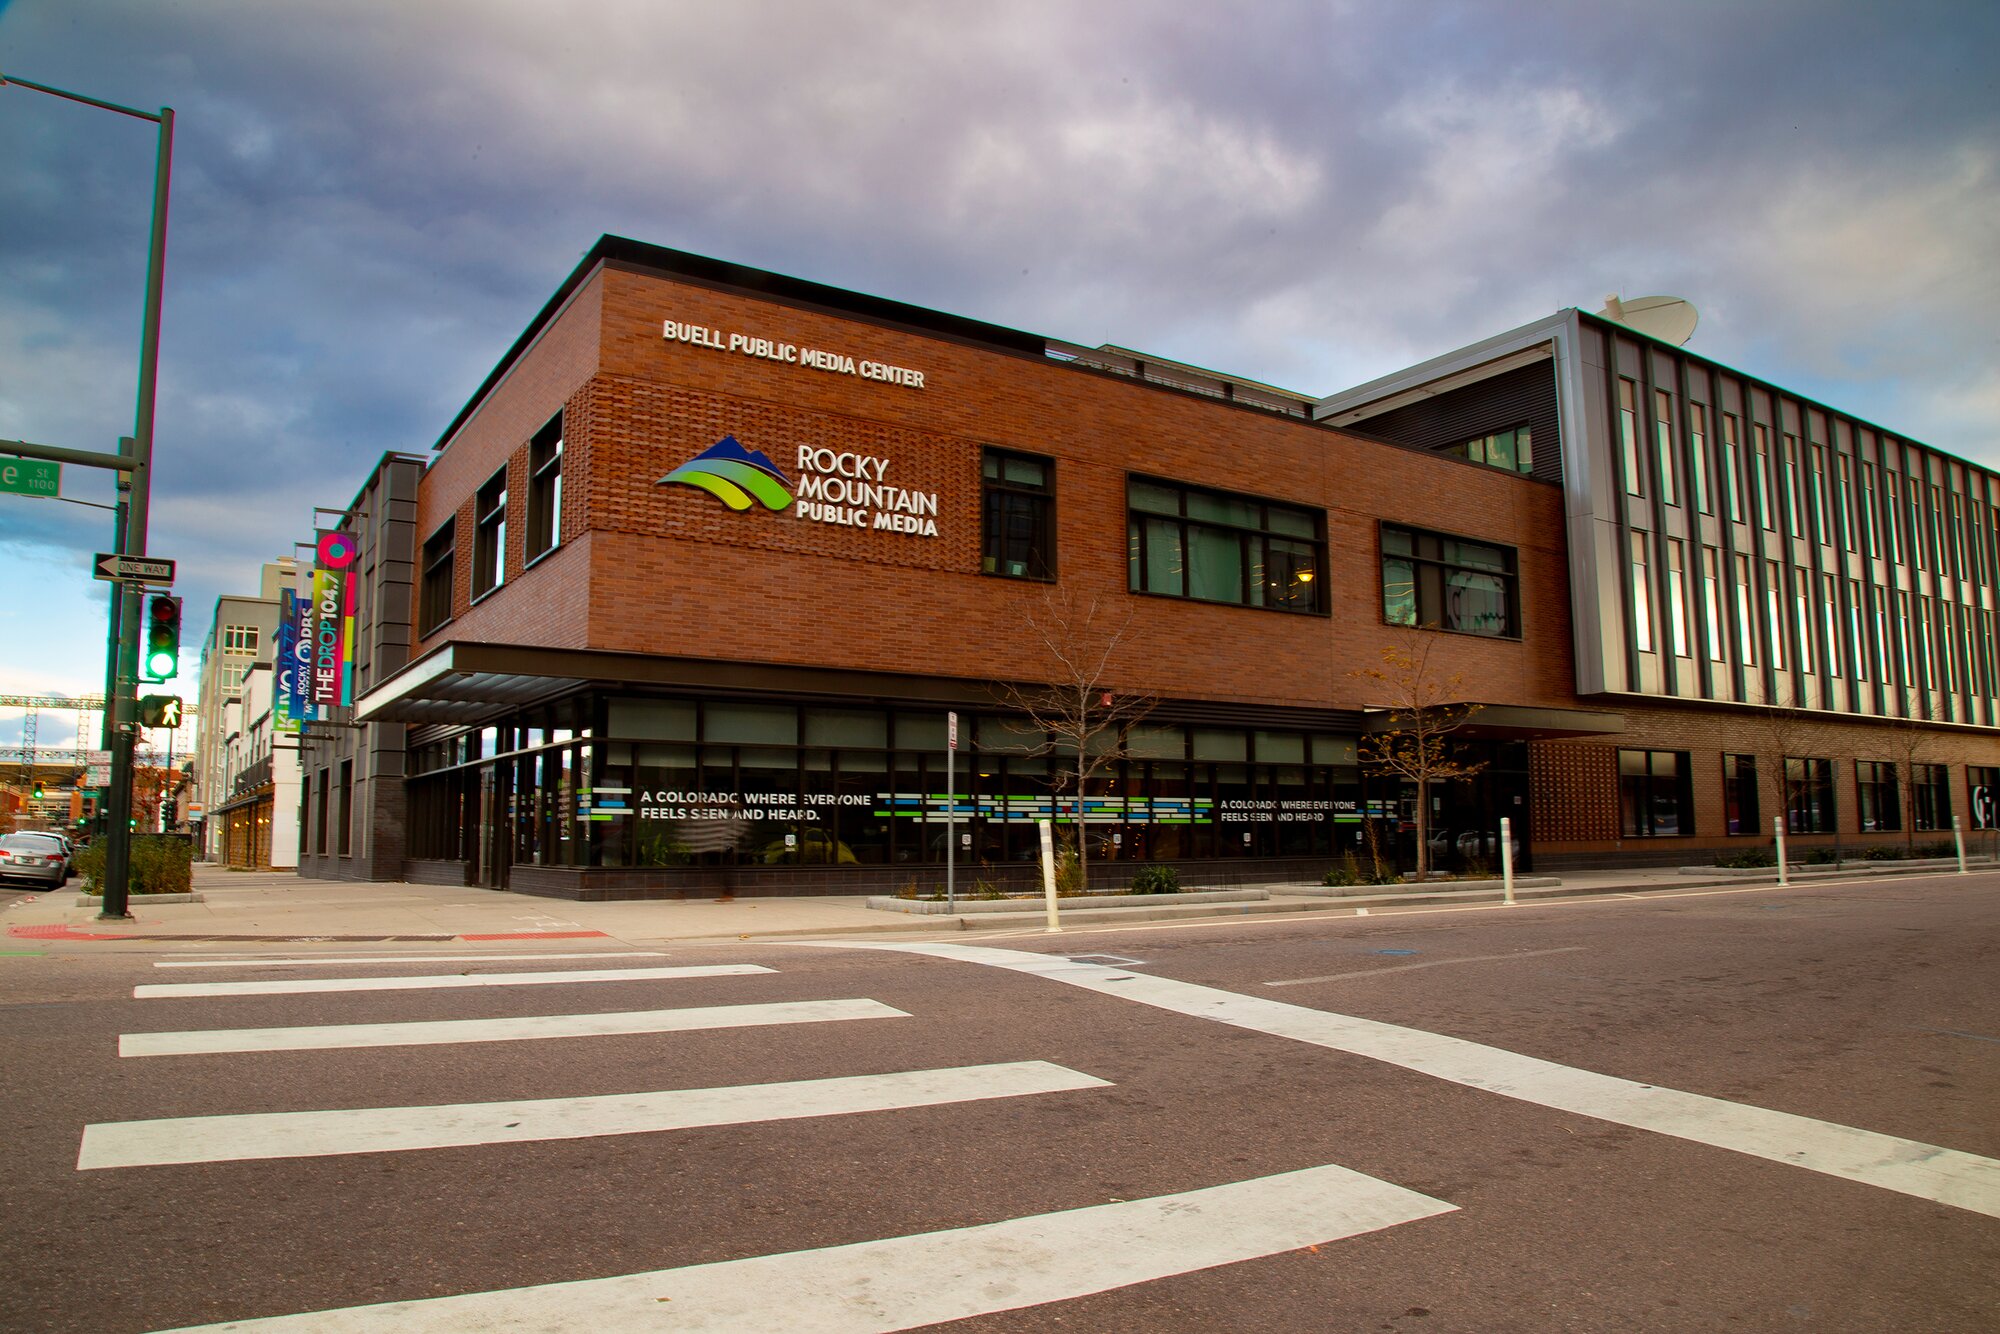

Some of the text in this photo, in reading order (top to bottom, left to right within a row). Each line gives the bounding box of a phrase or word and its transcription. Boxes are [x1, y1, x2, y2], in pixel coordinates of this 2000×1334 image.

[663, 320, 925, 388] BUELL PUBLIC MEDIA CENTER
[797, 445, 889, 482] ROCKY
[36, 468, 49, 478] St
[28, 479, 55, 490] 1100
[797, 474, 938, 516] MOUNTAIN
[796, 501, 938, 537] PUBLIC MEDIA
[118, 562, 167, 575] ONE WAY
[297, 664, 307, 696] ROCKY
[640, 791, 652, 803] A
[744, 793, 797, 805] WHERE
[1220, 799, 1228, 809] A
[1281, 800, 1312, 810] WHERE
[641, 807, 686, 820] FEELS
[690, 808, 728, 820] SEEN
[732, 809, 764, 820] AND
[1221, 812, 1248, 821] FEELS
[1250, 812, 1273, 821] SEEN
